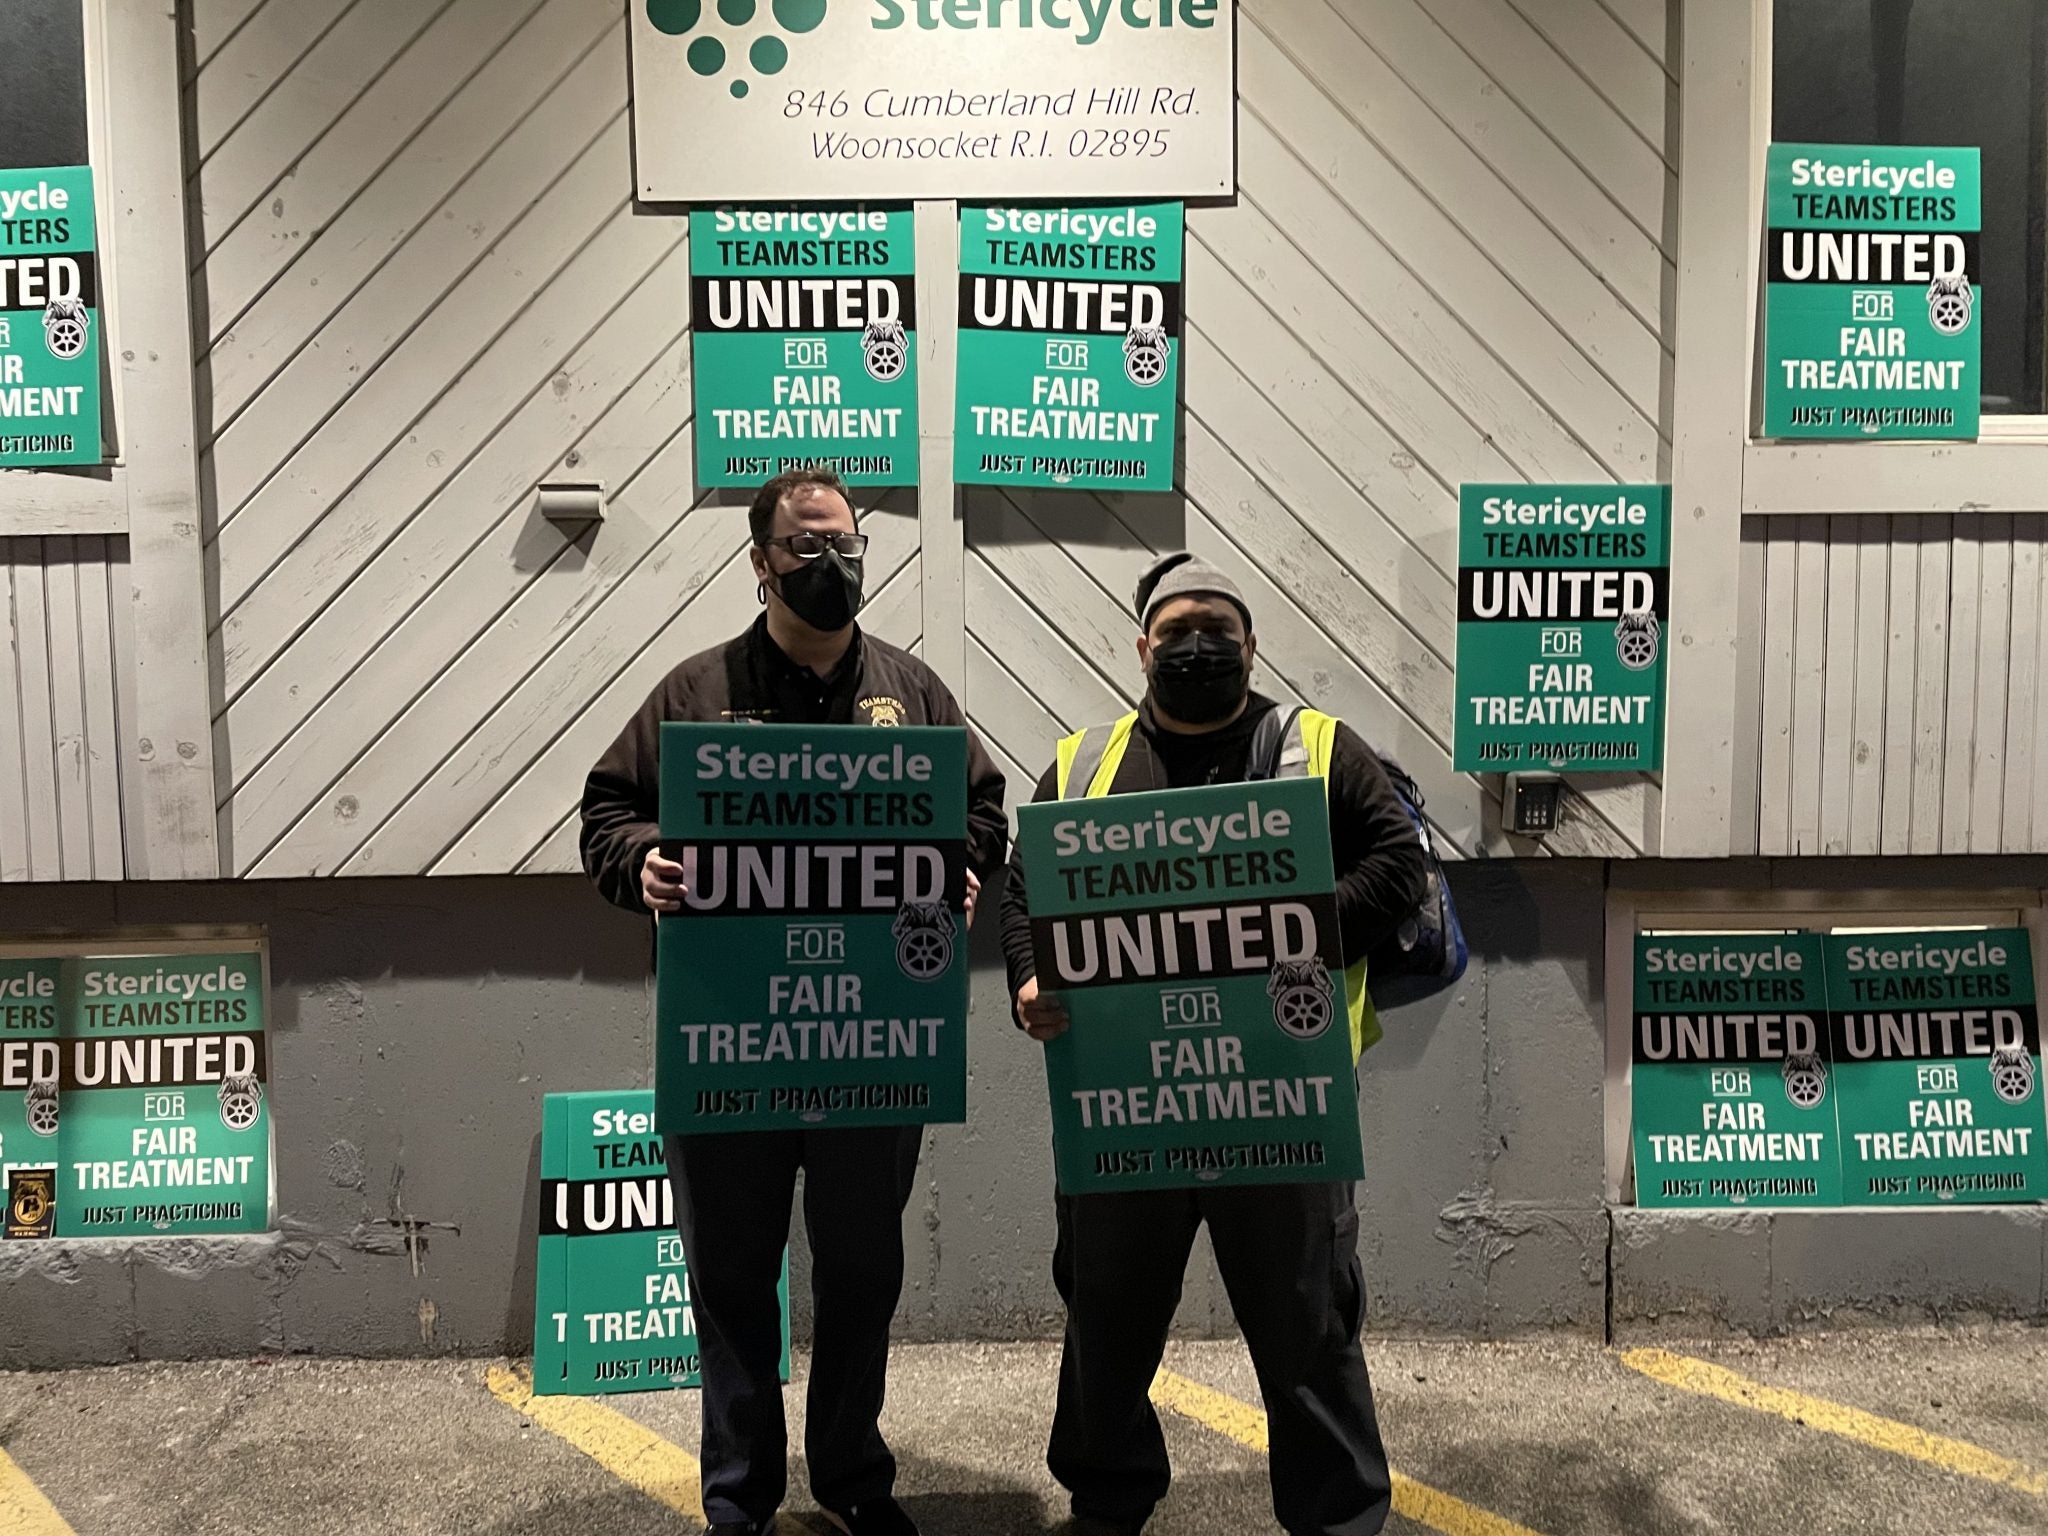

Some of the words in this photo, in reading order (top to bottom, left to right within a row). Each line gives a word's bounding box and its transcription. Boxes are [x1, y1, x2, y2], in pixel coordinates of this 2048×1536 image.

[784, 88, 850, 119] 846
[864, 87, 1075, 118] Cumberland
[1087, 86, 1139, 117] Hill
[1151, 86, 1201, 116] Rd.
[812, 131, 1002, 160] Woonsocket
[1010, 131, 1053, 159] R.I.
[1069, 129, 1170, 158] 02895
[1791, 159, 1956, 195] Stericycle
[715, 206, 887, 238] Stericycle
[1792, 193, 1956, 221] TEAMSTERS
[986, 207, 1157, 243] Stericycle
[717, 240, 889, 266] TEAMSTERS
[986, 240, 1157, 271] TEAMSTERS
[1782, 232, 1966, 281] UNITED
[708, 279, 899, 328] UNITED
[974, 278, 1164, 332] UNITED
[1852, 295, 1894, 317] FOR
[784, 342, 828, 366] FOR
[1046, 343, 1088, 367] FOR
[1840, 327, 1906, 356] FAIR
[773, 376, 841, 405] FAIR
[1781, 360, 1965, 390] TREATMENT
[1033, 376, 1100, 408] FAIR
[713, 408, 902, 438] TREATMENT
[971, 407, 1159, 443] TREATMENT
[1791, 406, 1836, 426] JUST
[1842, 407, 1954, 427] PRACTICING
[725, 456, 771, 475] JUST
[979, 454, 1027, 475] JUST
[1032, 456, 1147, 480] PRACTICING
[1483, 497, 1646, 532] Stericycle
[1483, 532, 1646, 558] TEAMSTERS
[1472, 571, 1654, 618] UNITED
[1541, 631, 1582, 653] FOR
[1528, 664, 1593, 692] FAIR
[1470, 696, 1651, 725] TREATMENT
[696, 743, 932, 789] Stericycle
[1479, 742, 1524, 761] JUST
[1529, 742, 1639, 762] PRACTICING
[696, 791, 933, 827] TEAMSTERS
[1053, 801, 1292, 857] Stericycle
[682, 845, 945, 910] UNITED
[1059, 848, 1298, 901] TEAMSTERS
[787, 928, 846, 959] FOR
[1052, 902, 1318, 983] UNITED
[1645, 945, 1803, 978] Stericycle
[1846, 941, 2007, 976] Stericycle
[84, 965, 247, 1000] Stericycle
[769, 975, 862, 1015] FAIR
[1648, 978, 1805, 1004] TEAMSTERS
[1849, 973, 2011, 1002] TEAMSTERS
[85, 999, 247, 1028] TEAMSTERS
[1160, 991, 1222, 1024] FOR
[680, 1018, 945, 1064] TREATMENT
[1641, 1014, 1816, 1060] UNITED
[1843, 1009, 2025, 1059] UNITED
[74, 1035, 255, 1086] UNITED
[1150, 1035, 1245, 1079] FAIR
[1712, 1072, 1751, 1093] FOR
[1917, 1068, 1959, 1091] FOR
[144, 1096, 185, 1117] FOR
[694, 1088, 761, 1116] JUST
[770, 1083, 930, 1112] PRACTICING
[1072, 1076, 1333, 1129] TREATMENT
[1908, 1099, 1974, 1128] FAIR
[1702, 1102, 1766, 1131] FAIR
[132, 1127, 196, 1156] FAIR
[1648, 1133, 1824, 1163] TREATMENT
[1854, 1128, 2032, 1161] TREATMENT
[73, 1156, 254, 1190] TREATMENT
[1095, 1148, 1155, 1176] JUST
[1165, 1141, 1326, 1171] PRACTICING
[1661, 1178, 1703, 1198] JUST
[1710, 1176, 1818, 1197] PRACTICING
[1868, 1175, 1911, 1195] JUST
[1917, 1172, 2026, 1193] PRACTICING
[82, 1206, 127, 1224] JUST
[133, 1202, 242, 1222] PRACTICING
[594, 1359, 642, 1381] JUST
